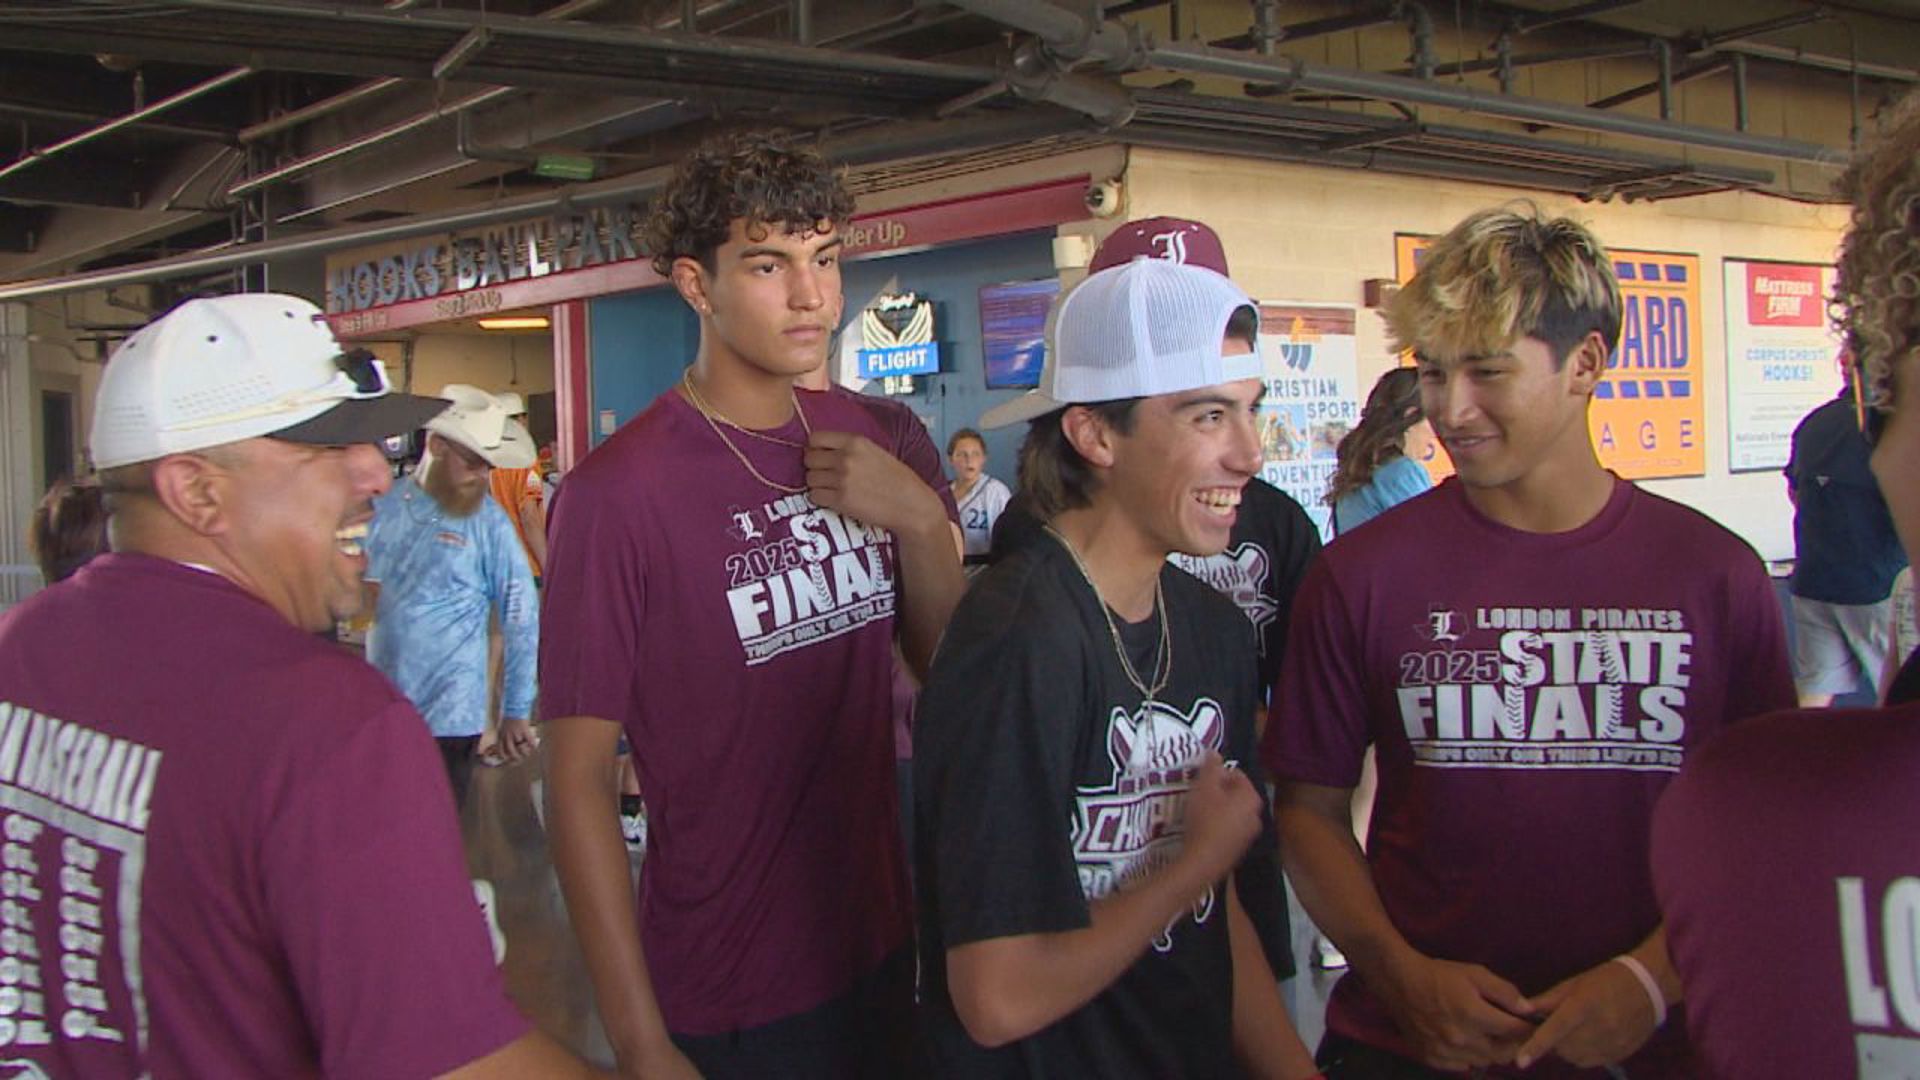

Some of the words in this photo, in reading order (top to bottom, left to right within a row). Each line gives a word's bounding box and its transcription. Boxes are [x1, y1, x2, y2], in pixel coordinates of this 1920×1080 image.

[843, 226, 874, 247] der
[878, 219, 906, 247] Up
[330, 246, 441, 312] HOOKS
[456, 208, 650, 290] BALLPAR
[1755, 276, 1814, 296] MATTRESS
[1607, 295, 1689, 369] ARD
[867, 348, 928, 372] FLIGHT
[1265, 377, 1337, 398] HRISTIAN
[1600, 420, 1693, 451] AGE
[764, 492, 816, 523] LOND
[732, 511, 763, 541] L
[726, 537, 804, 591] 2025
[726, 544, 892, 645] FINAL
[1429, 611, 1460, 641] L
[1476, 608, 1571, 630] LONDON
[1581, 608, 1684, 630] PIRATES
[1400, 650, 1502, 685] 2025
[1500, 629, 1692, 688] STATE
[1396, 684, 1686, 743] FINALS
